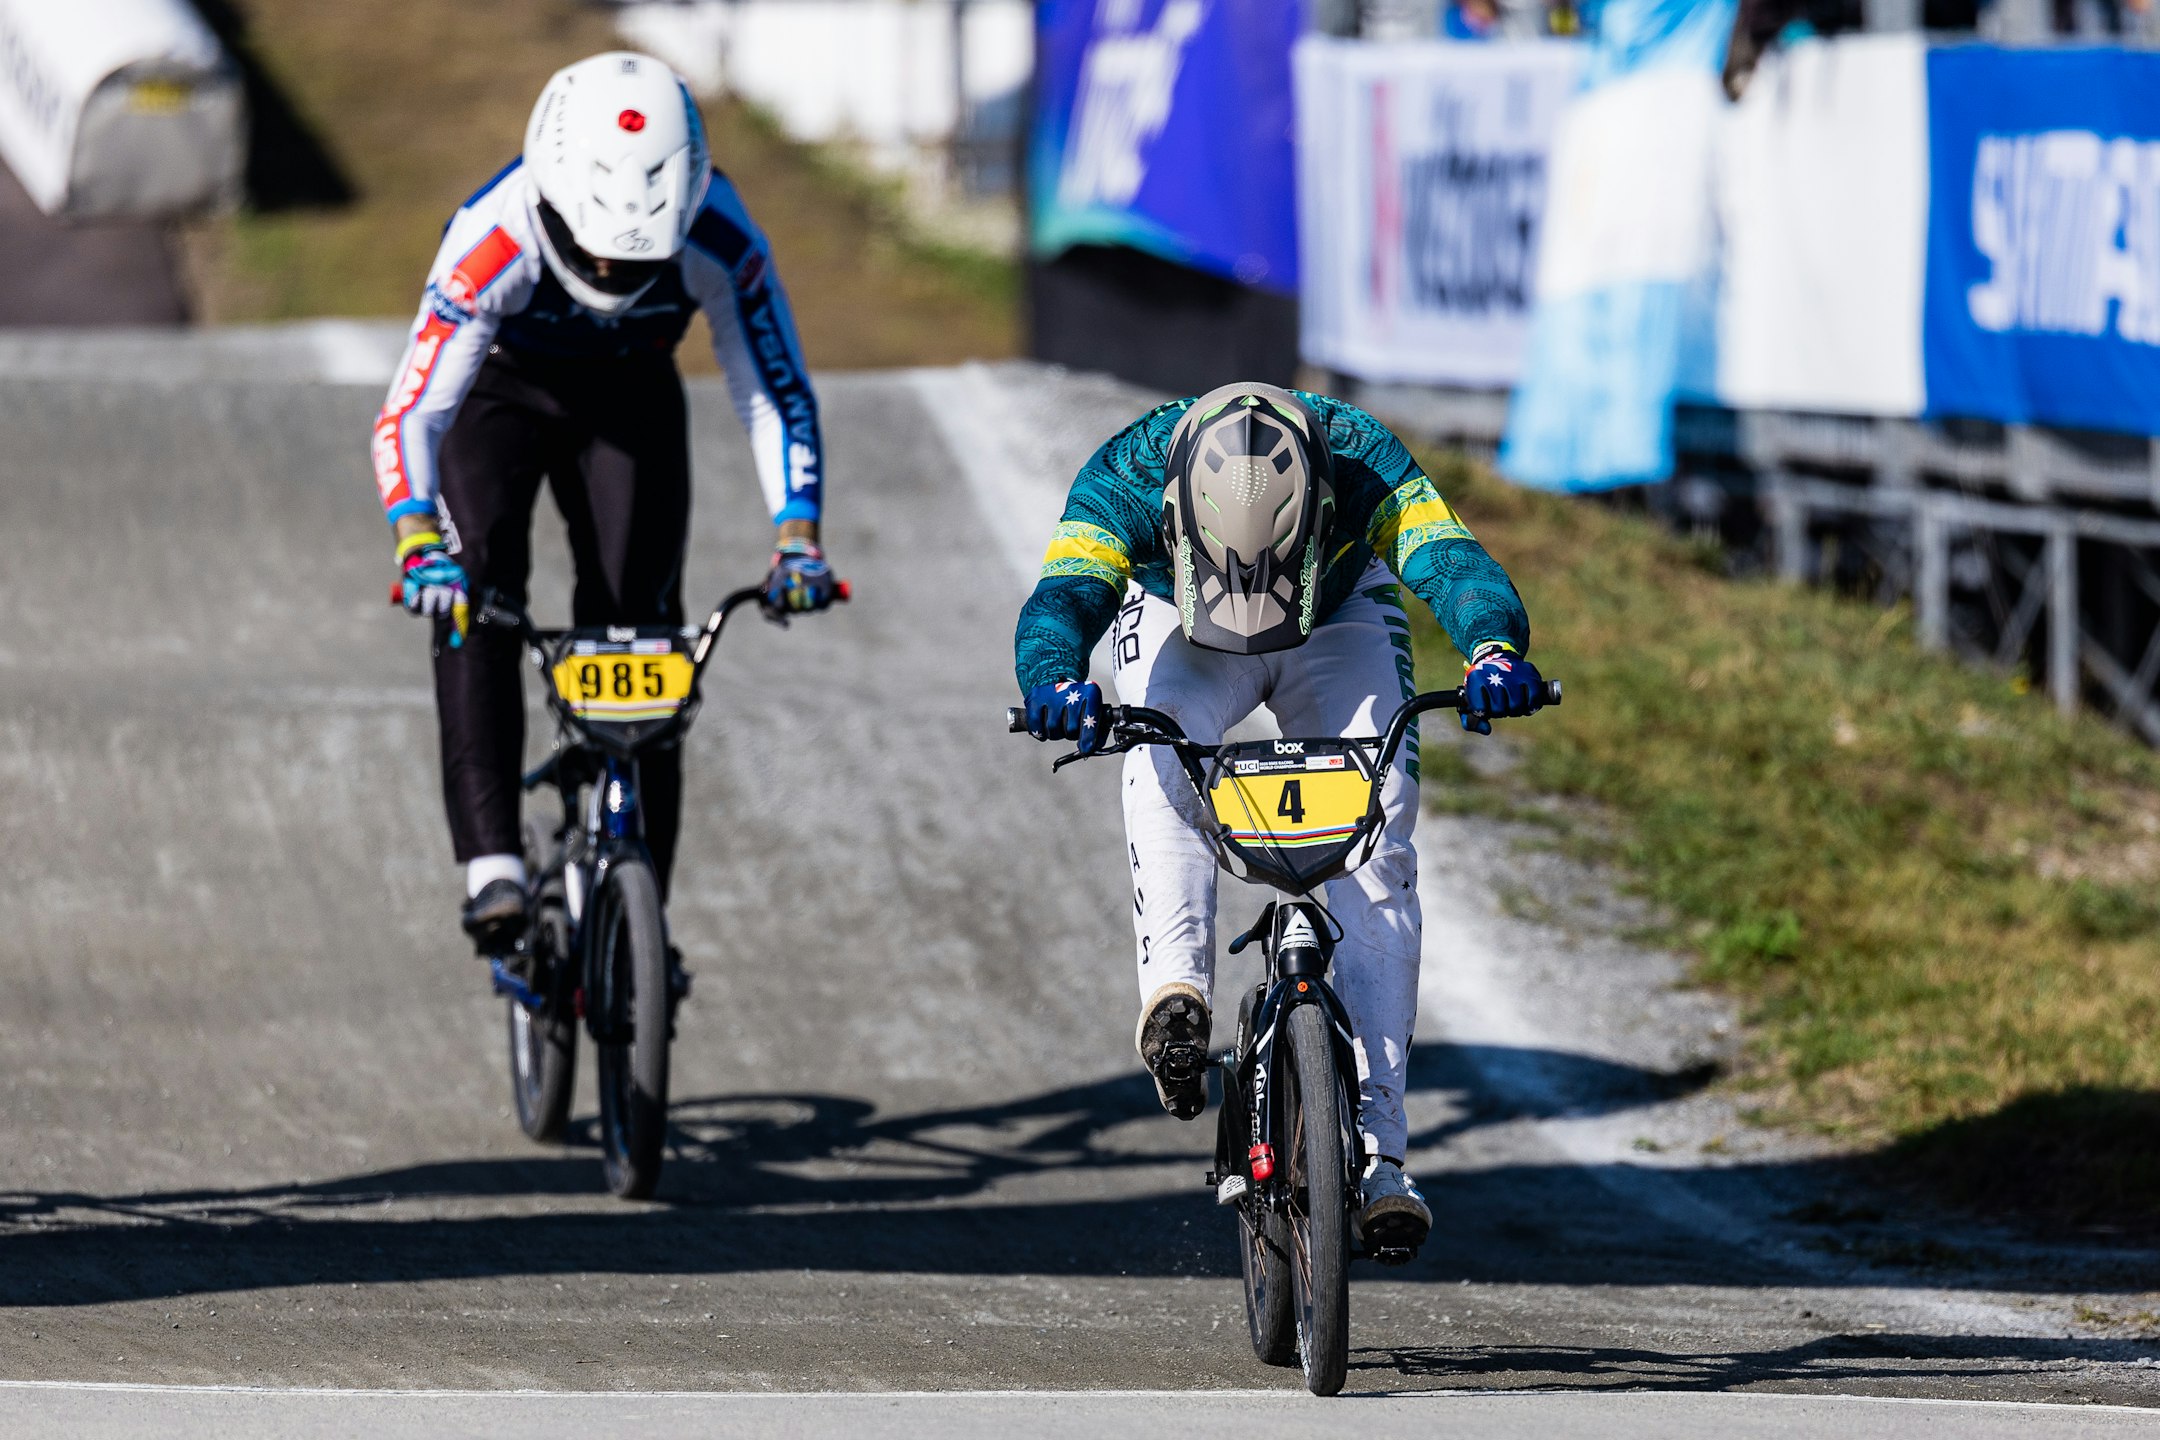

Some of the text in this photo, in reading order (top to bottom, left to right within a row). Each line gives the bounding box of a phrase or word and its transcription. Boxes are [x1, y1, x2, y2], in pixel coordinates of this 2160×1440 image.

[751, 304, 819, 493] TEAM USA
[373, 334, 441, 499] TEAM USA
[1184, 562, 1195, 585] Lee
[1299, 585, 1313, 611] Lee
[581, 663, 663, 698] 985
[1273, 740, 1305, 754] box
[1239, 762, 1258, 771] UCI
[1277, 779, 1305, 824] 4
